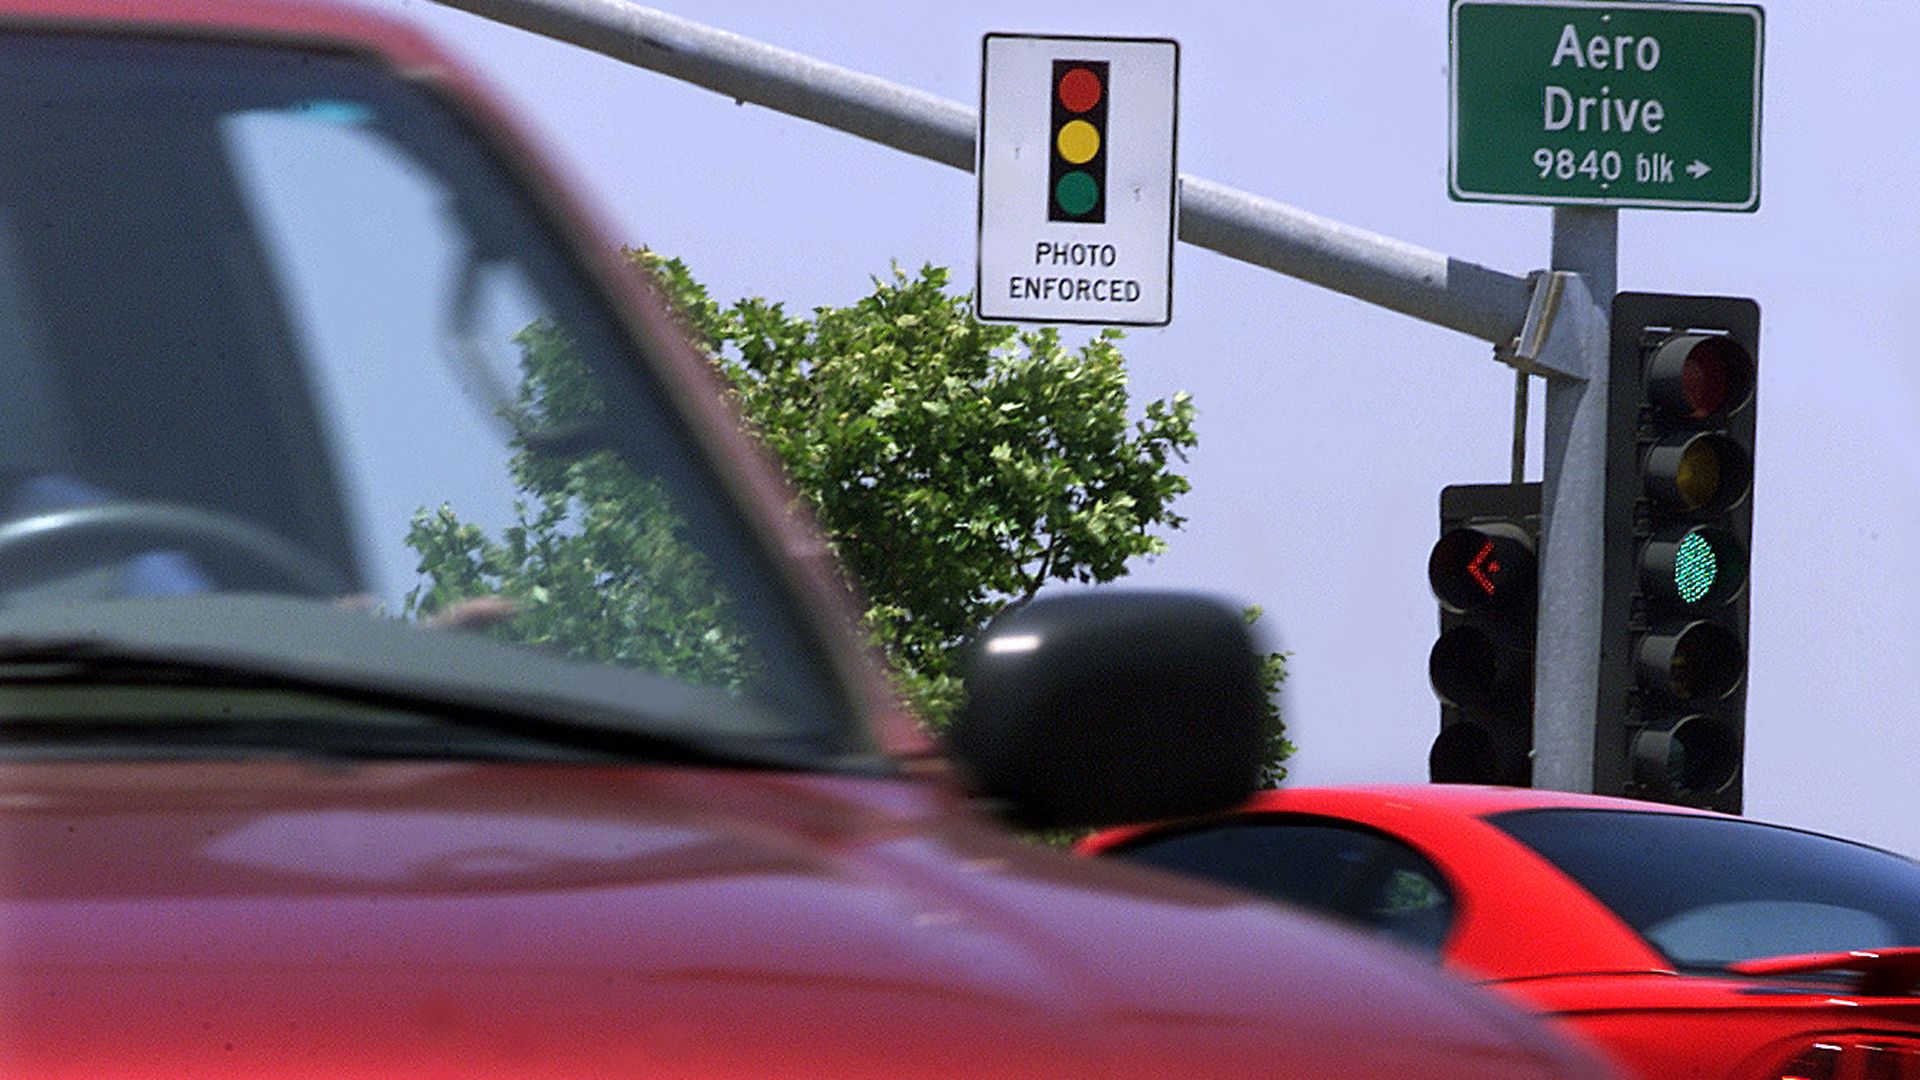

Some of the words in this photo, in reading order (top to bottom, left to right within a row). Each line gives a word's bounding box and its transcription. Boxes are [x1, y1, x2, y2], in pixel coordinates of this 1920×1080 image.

[1551, 24, 1661, 71] Aero
[1543, 85, 1665, 132] Drive
[1533, 148, 1622, 180] 9840
[1635, 153, 1674, 183] blk
[1035, 242, 1117, 267] PHOTO
[1009, 277, 1141, 302] ENFORCED
